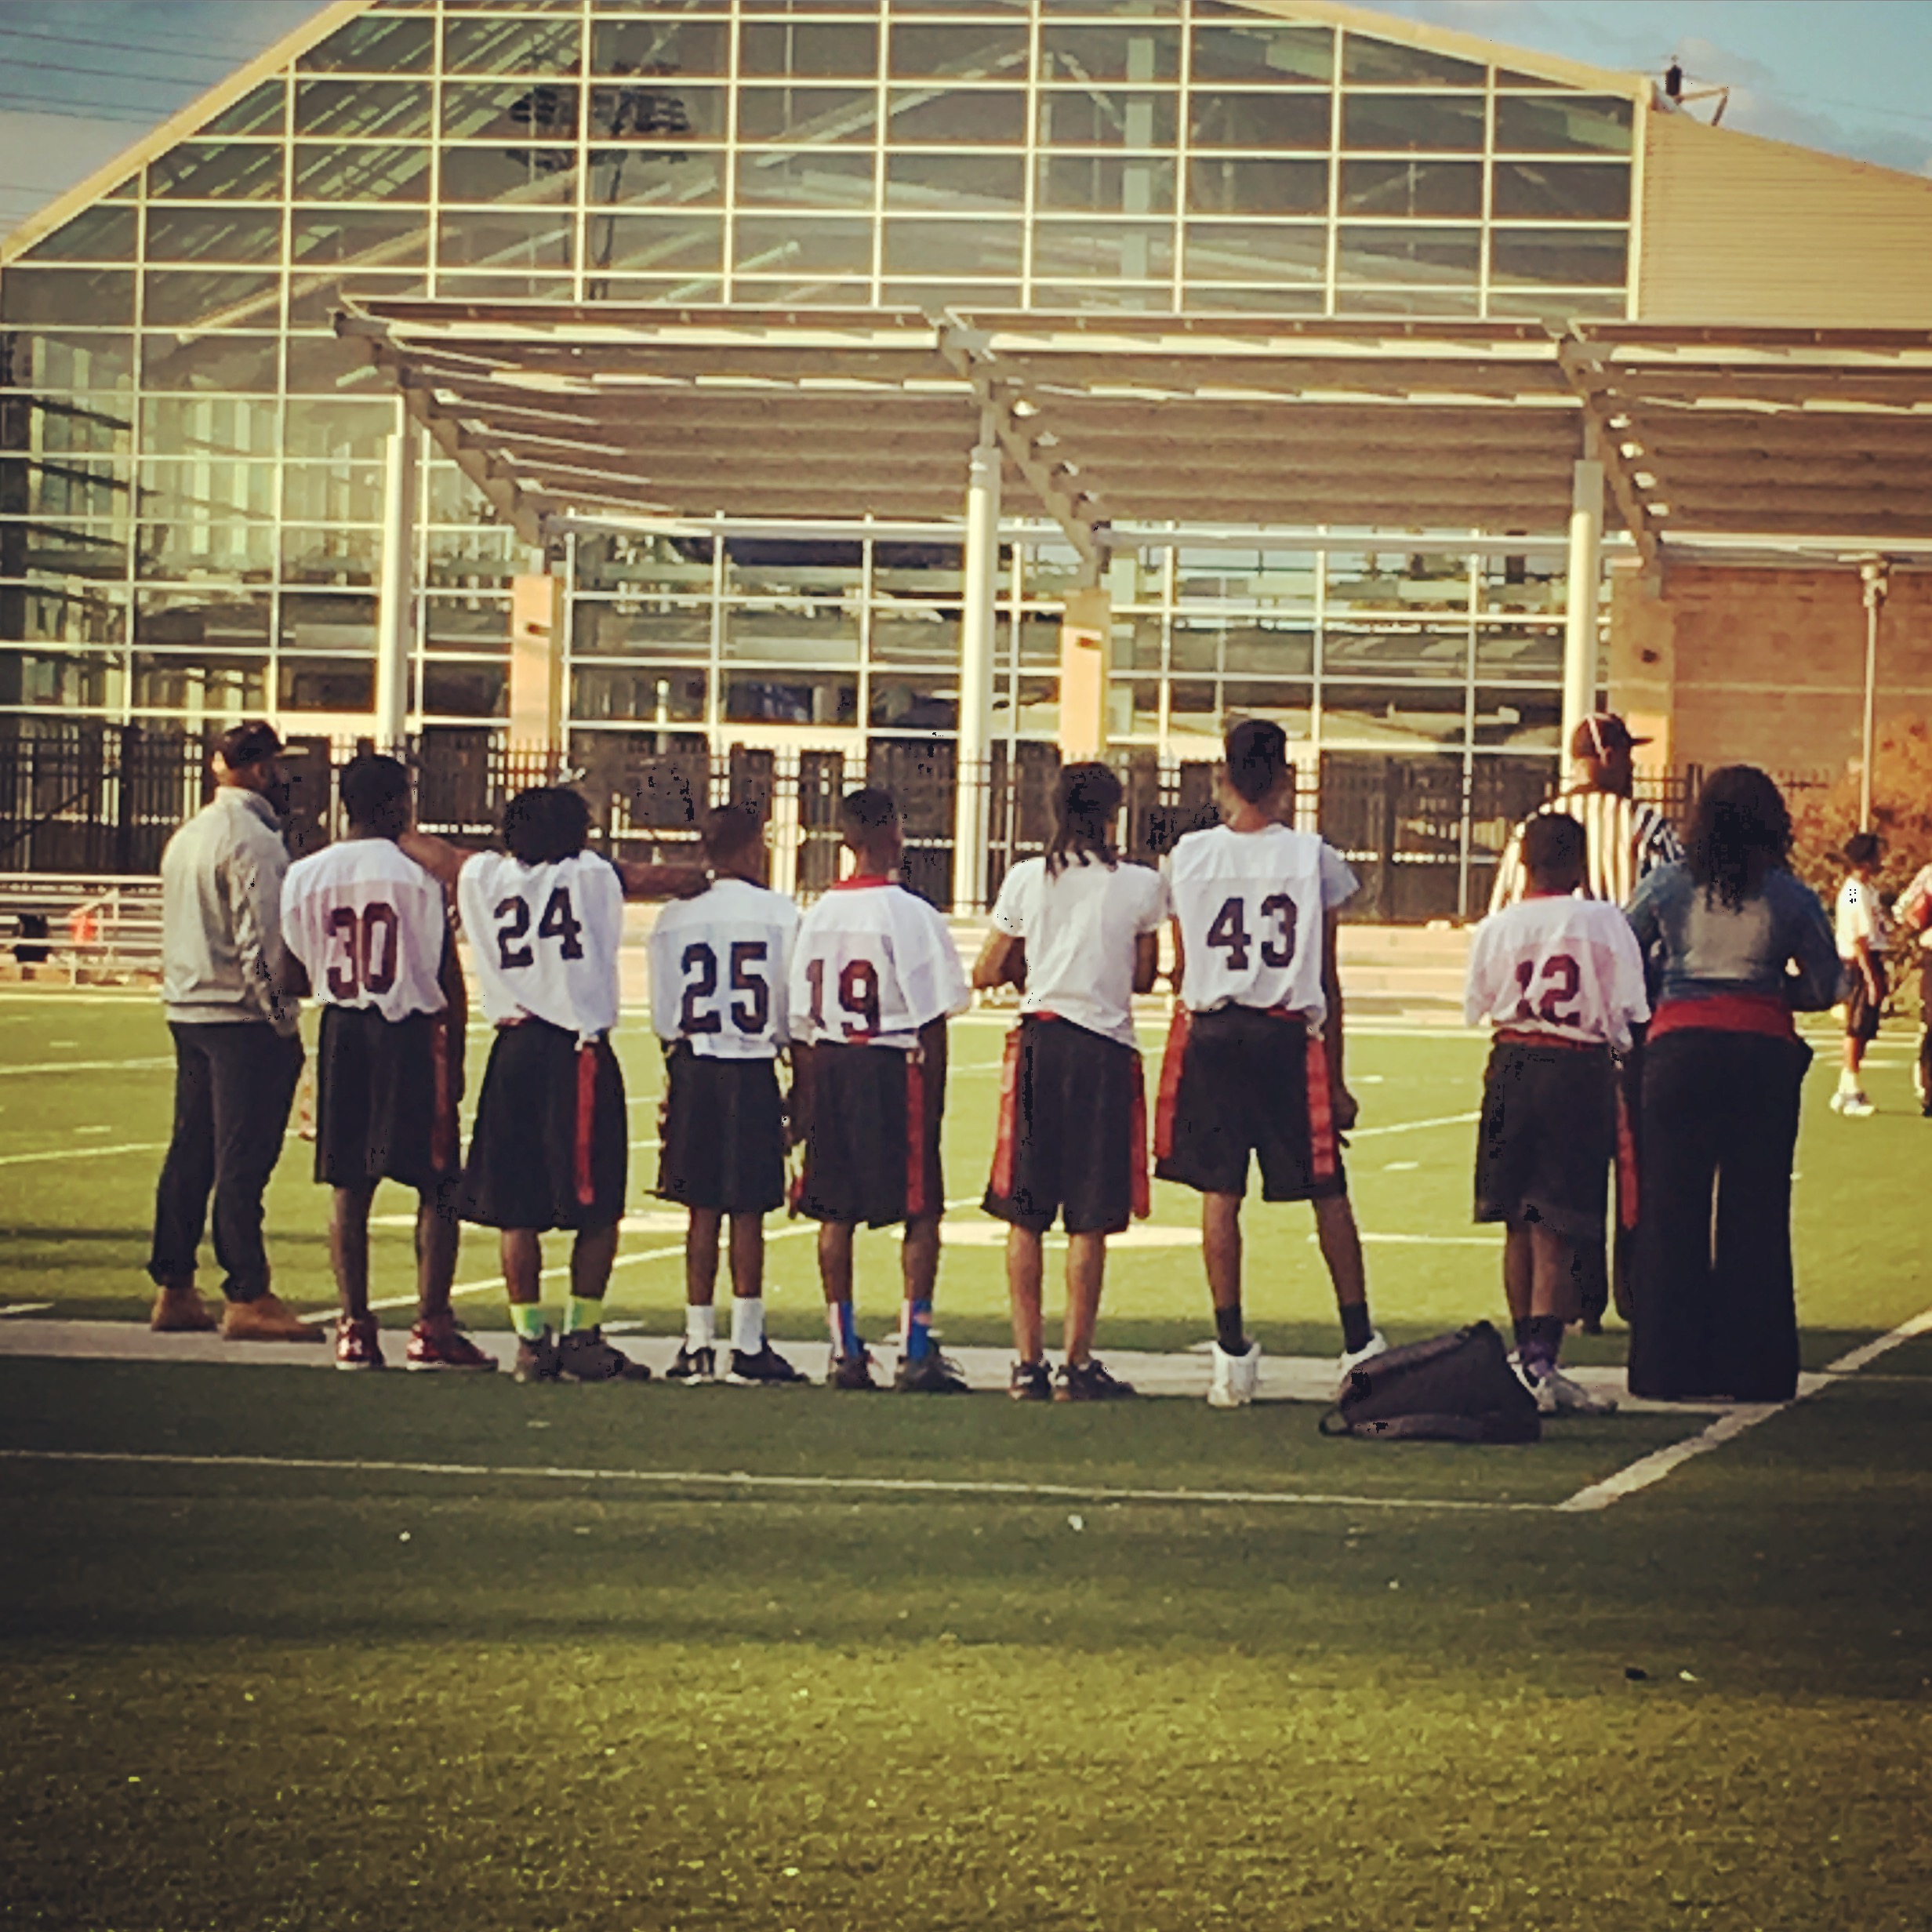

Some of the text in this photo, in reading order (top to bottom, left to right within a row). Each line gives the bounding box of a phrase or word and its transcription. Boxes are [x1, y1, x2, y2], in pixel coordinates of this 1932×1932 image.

[327, 902, 398, 1000] 30
[493, 887, 584, 970] 24
[1206, 893, 1298, 971] 43
[678, 941, 769, 1033] 25
[806, 958, 880, 1037] 19
[1515, 953, 1581, 1027] 12
